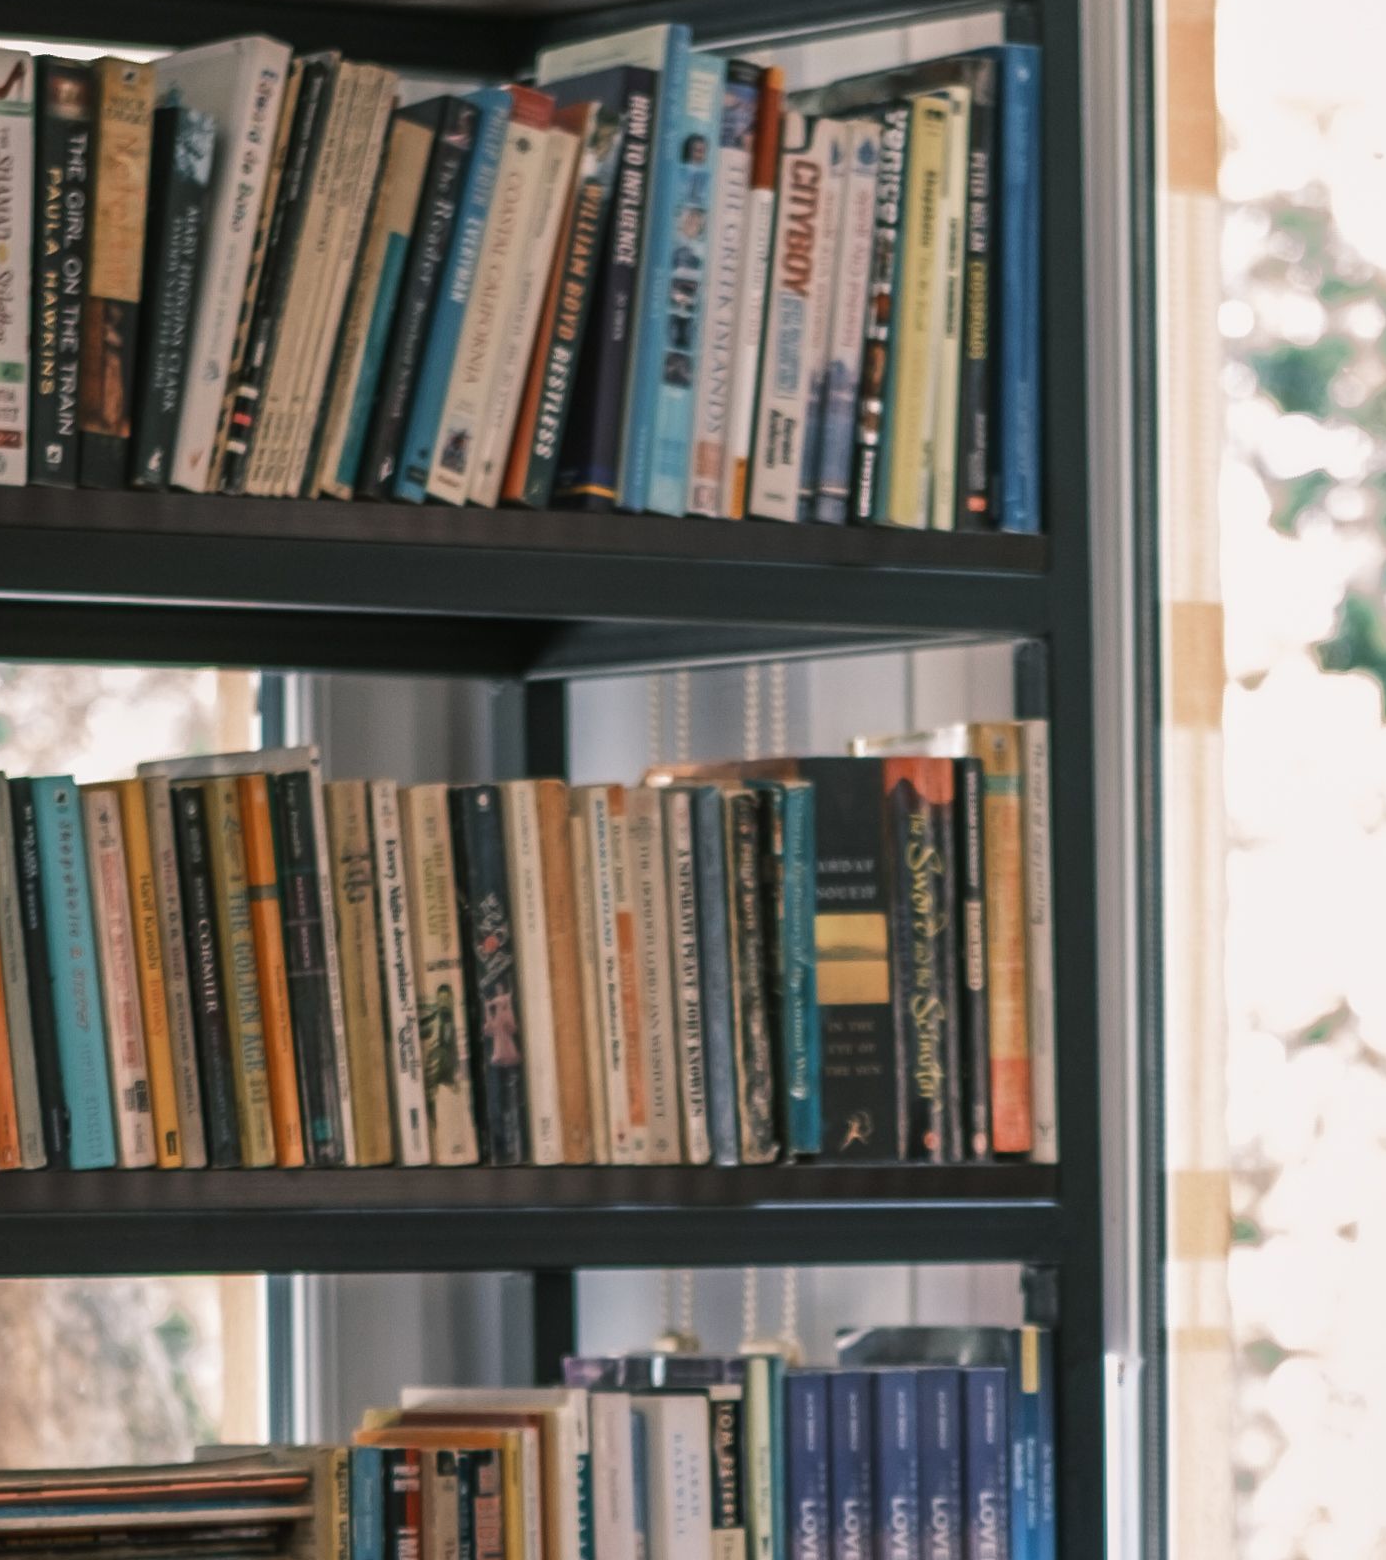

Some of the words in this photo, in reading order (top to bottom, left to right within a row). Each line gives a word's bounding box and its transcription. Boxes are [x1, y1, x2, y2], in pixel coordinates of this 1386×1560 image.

[627, 94, 652, 137] HOW
[65, 133, 87, 183] THE
[623, 143, 647, 166] TO
[42, 167, 62, 256] PAULA
[63, 192, 86, 247] GIRL
[417, 199, 454, 287] Reader
[570, 183, 603, 278] WILLIAM
[613, 169, 644, 268] INFLUENCE
[781, 158, 823, 298] CITYBOY
[62, 258, 83, 295] ON
[448, 215, 486, 303] EVERYMAN
[715, 222, 741, 311] GREEK
[40, 272, 58, 397] HAWKINS
[61, 303, 81, 354] THE
[461, 265, 502, 385] CALIFORNIA
[556, 280, 588, 341] BOYD
[57, 361, 78, 437] TRAIN
[534, 346, 573, 460] RESTLESS
[706, 320, 737, 434] ISLANDS
[1032, 743, 1044, 769] The
[909, 810, 927, 836] The
[139, 873, 155, 912] Hanif
[227, 890, 251, 932] THE
[678, 860, 697, 935] SEPARATE
[907, 842, 949, 938] Sword
[143, 915, 158, 970] Kureishi
[196, 918, 218, 1015] CORMIER
[682, 942, 699, 989] PEACE
[234, 941, 258, 1026] GOLDEN
[684, 999, 701, 1040] JOHN
[243, 1033, 265, 1074] AGE
[687, 1044, 705, 1118] KNOWLES
[911, 994, 947, 1113] Scimitar
[717, 1402, 734, 1444] TOM
[336, 1461, 348, 1514] Agatha
[673, 1432, 686, 1536] BAKEWELL
[688, 1452, 701, 1518] SARAH
[718, 1456, 736, 1528] PETERS
